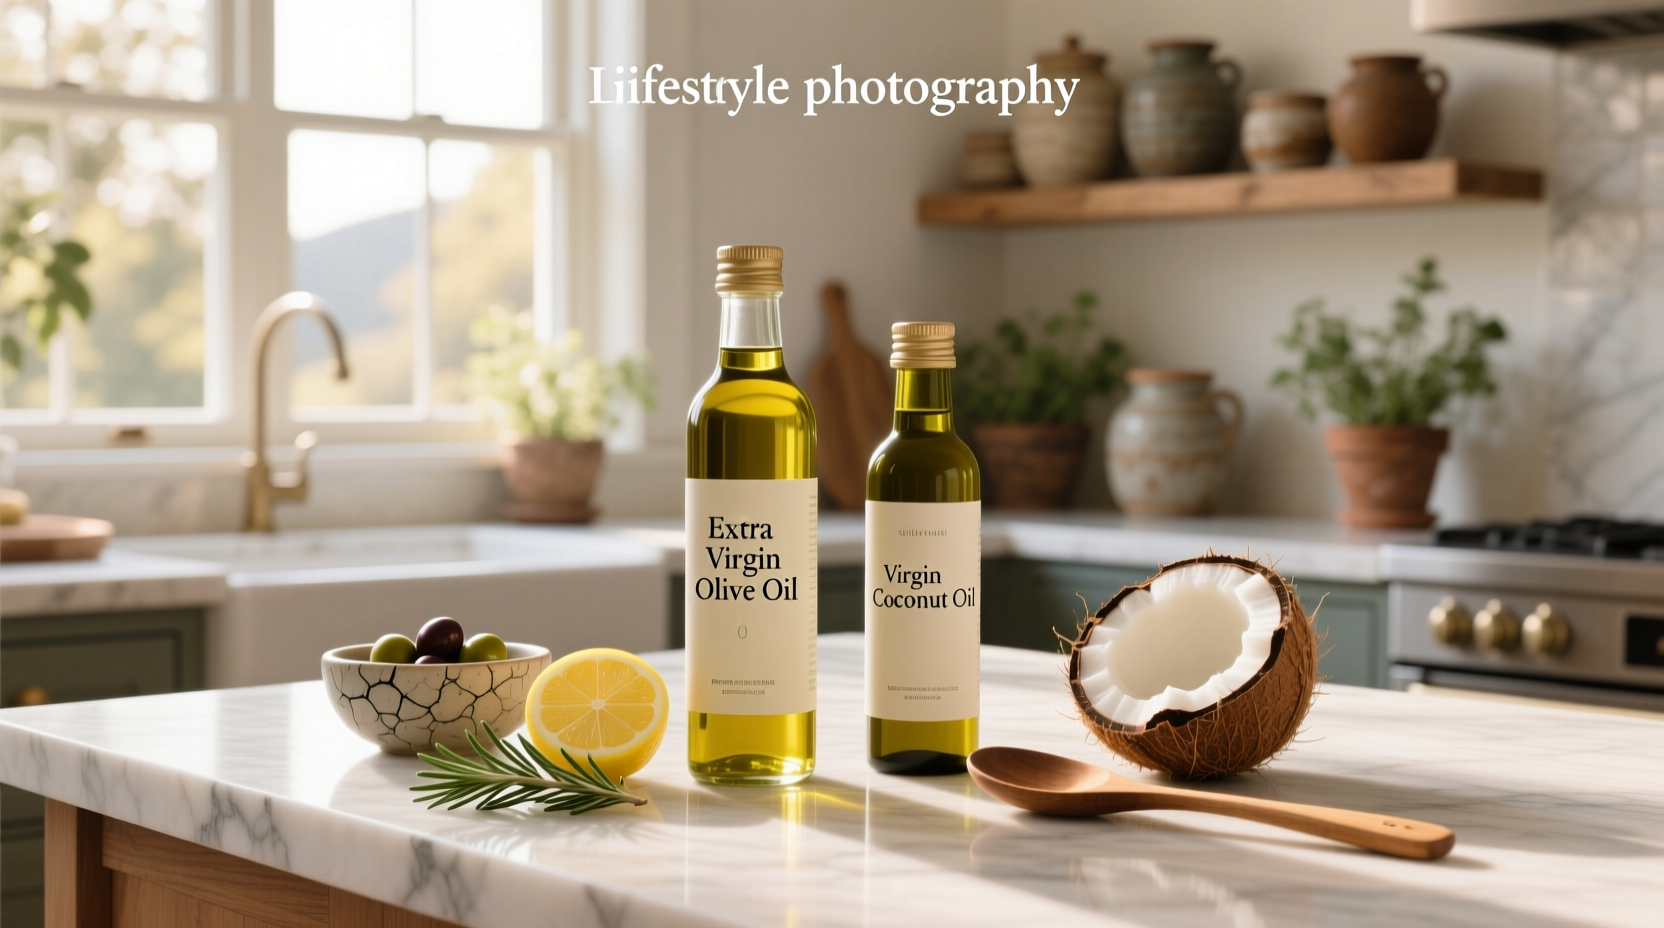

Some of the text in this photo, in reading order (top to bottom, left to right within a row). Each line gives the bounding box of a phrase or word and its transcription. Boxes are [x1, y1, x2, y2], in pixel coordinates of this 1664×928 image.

[707, 516, 773, 539] Extra
[705, 546, 781, 577] Virgin
[695, 576, 798, 601] Olive Oil
[883, 564, 942, 590] Virgin
[872, 586, 975, 609] Coconut Oil
